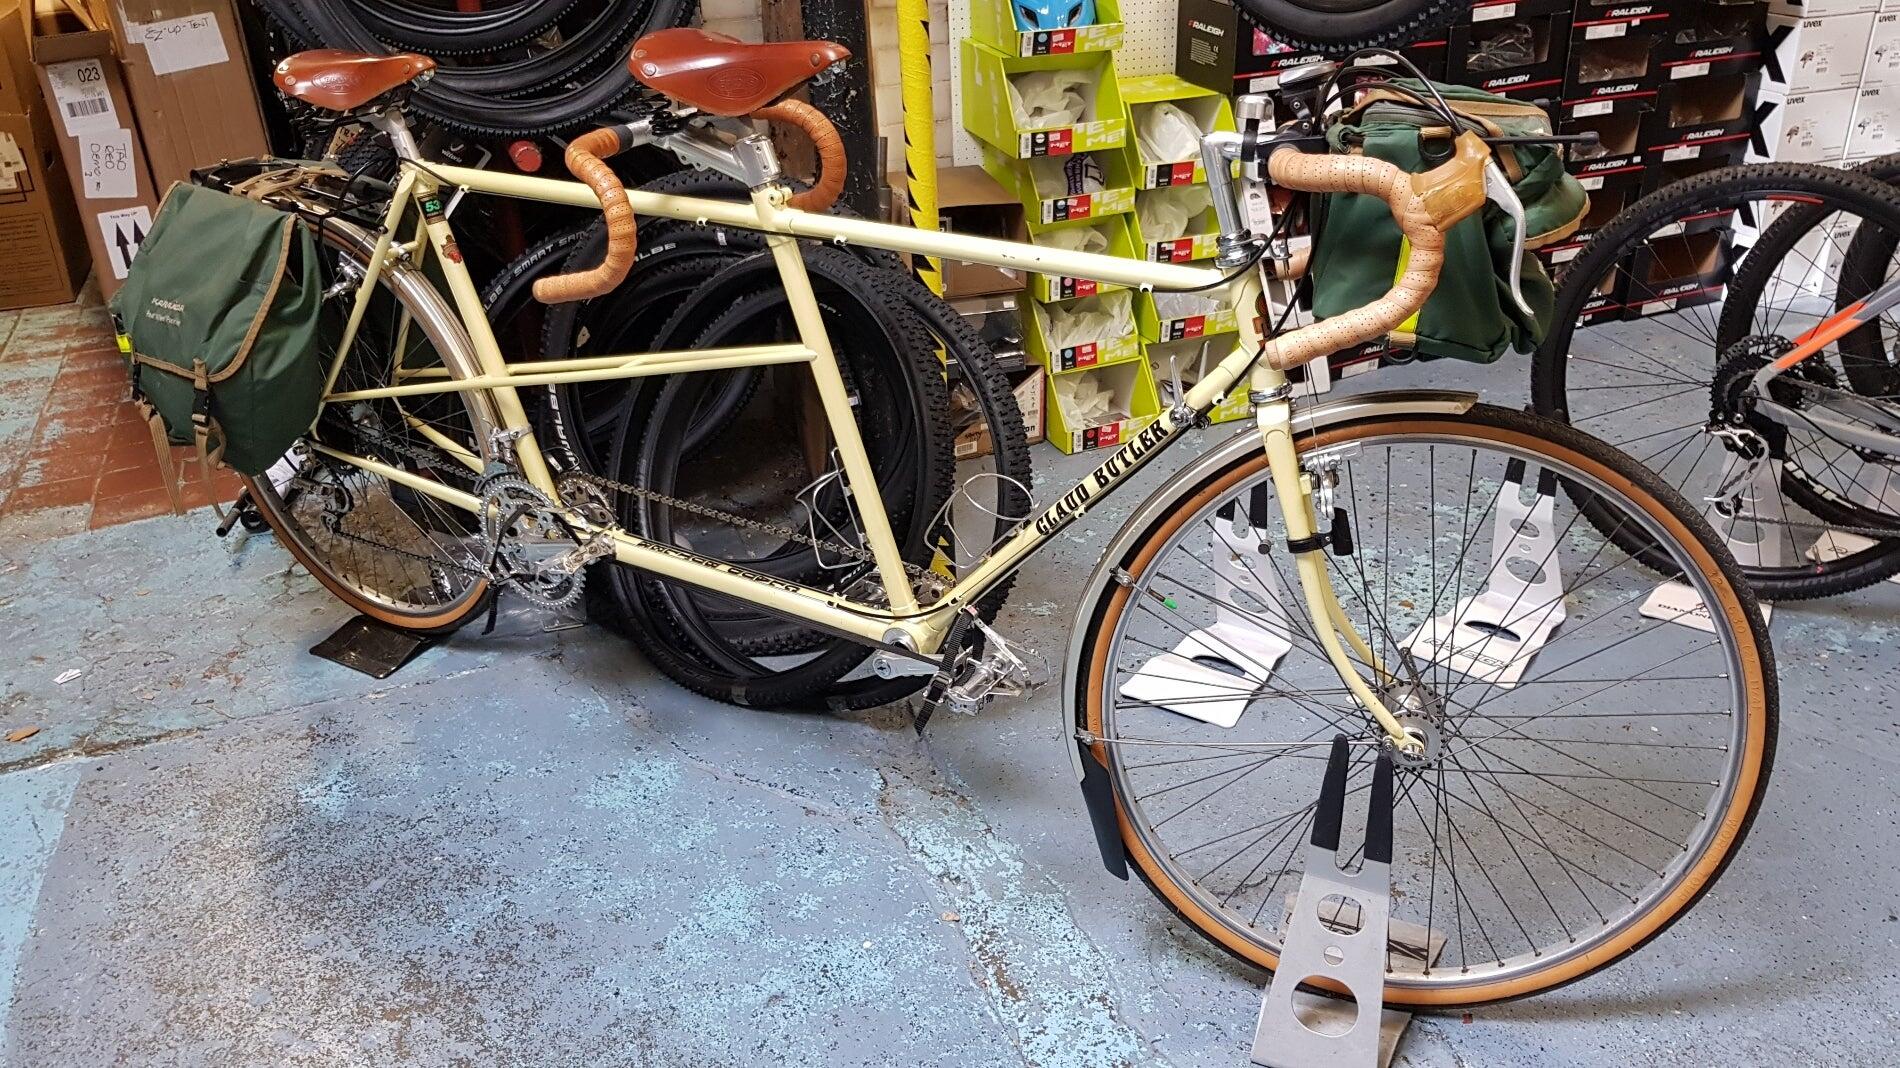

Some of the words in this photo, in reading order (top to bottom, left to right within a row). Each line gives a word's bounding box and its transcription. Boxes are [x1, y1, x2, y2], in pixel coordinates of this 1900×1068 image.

[1611, 6, 1652, 17] RALEIGH
[1803, 20, 1822, 28] uvex
[1879, 15, 1897, 23] uvex
[1192, 21, 1225, 37] RALEIGH
[1694, 47, 1733, 57] RALEIGH
[1278, 56, 1323, 67] RALEIGH
[78, 67, 100, 82] 023
[1488, 74, 1530, 87] RALEIGH
[1597, 84, 1638, 95] RALEIGH
[1862, 89, 1880, 97] uvex
[1787, 96, 1805, 105] uvex
[1686, 129, 1724, 140] RALEIGH
[1588, 159, 1627, 171] RALEIGH
[515, 246, 552, 278] SMART
[1036, 483, 1090, 536] CLAUD
[1092, 419, 1169, 488] BUTLER
